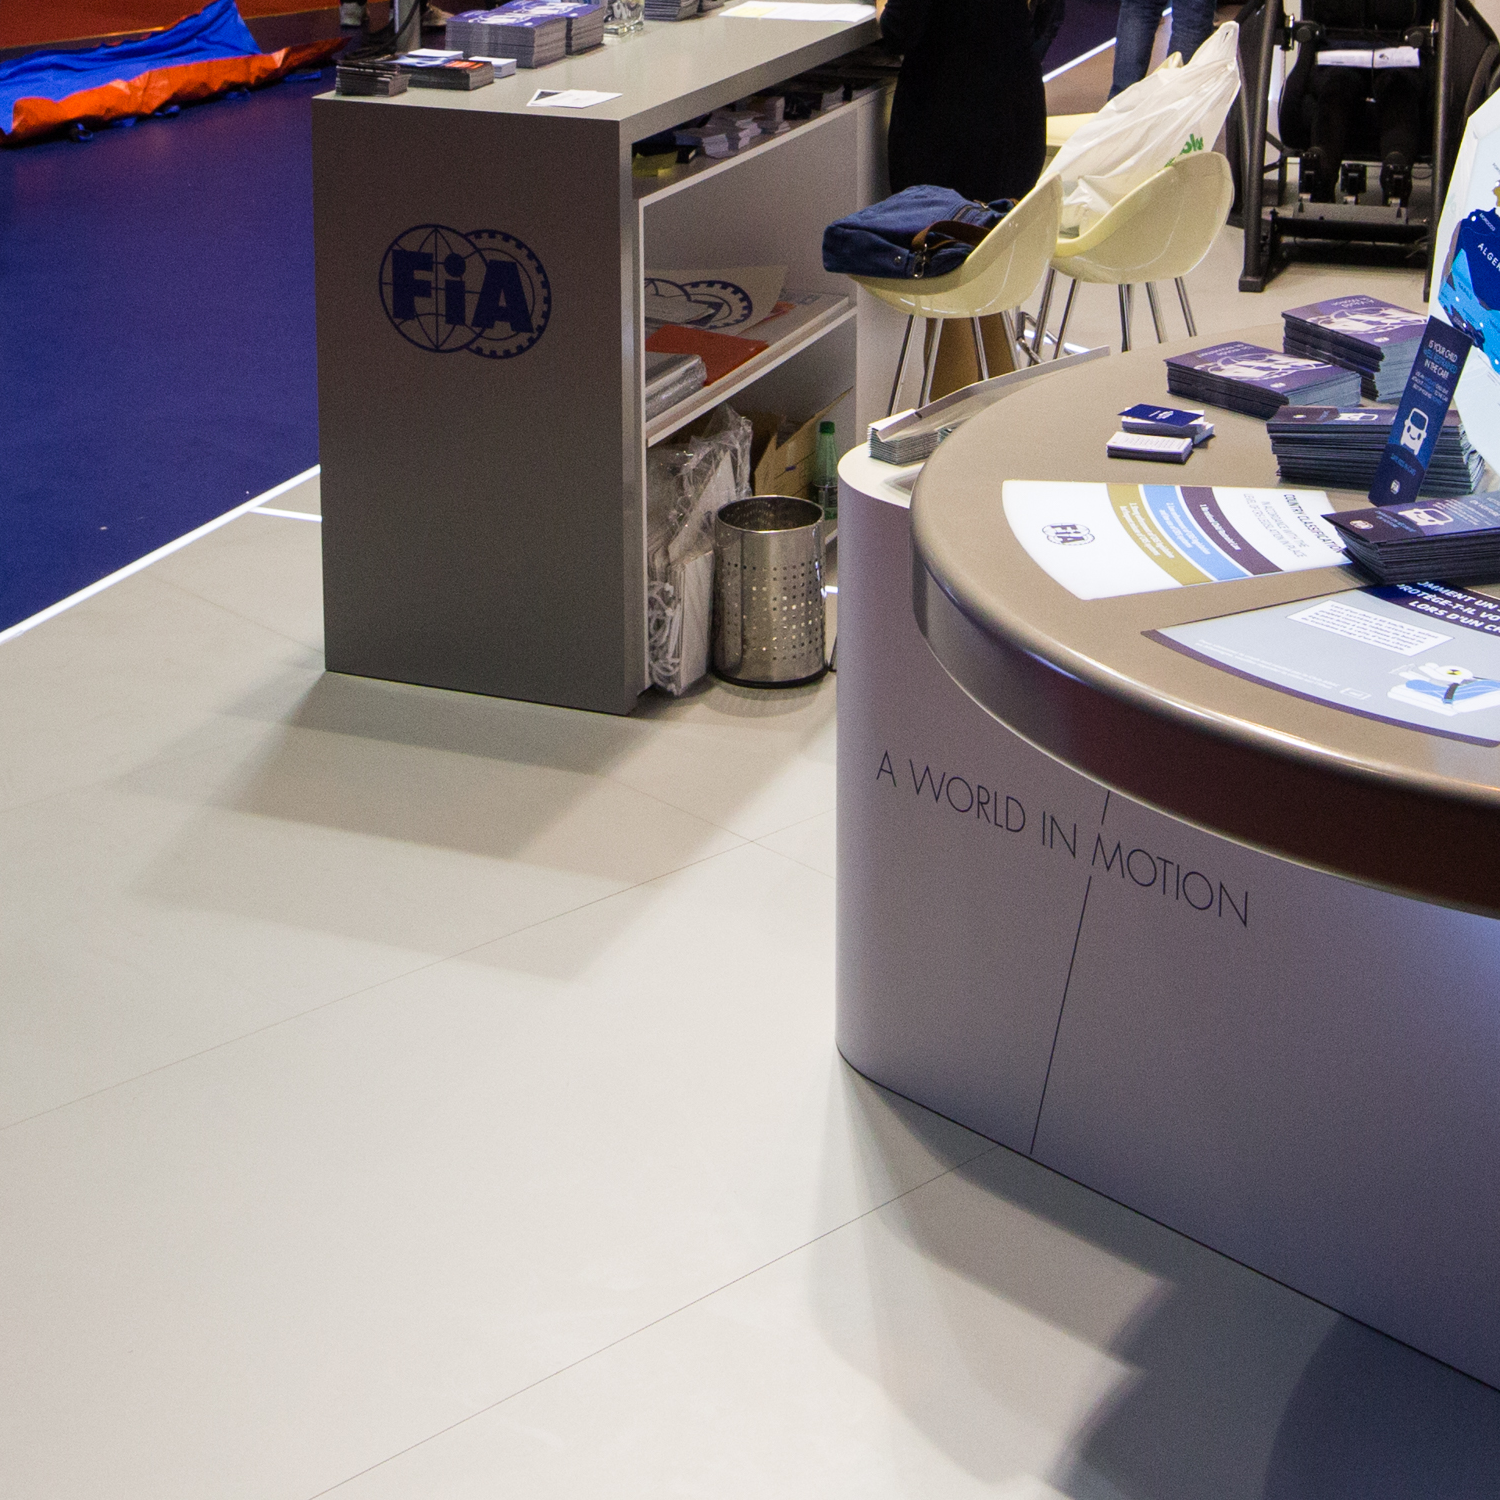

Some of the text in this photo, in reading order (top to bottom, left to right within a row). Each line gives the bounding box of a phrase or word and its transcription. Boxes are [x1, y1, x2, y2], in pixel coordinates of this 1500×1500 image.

[390, 248, 532, 335] FiA
[1408, 600, 1449, 617] LORS
[1446, 612, 1485, 628] D'UN
[1474, 599, 1499, 610] UN
[875, 750, 1250, 927] A WORLD IN MOTION
